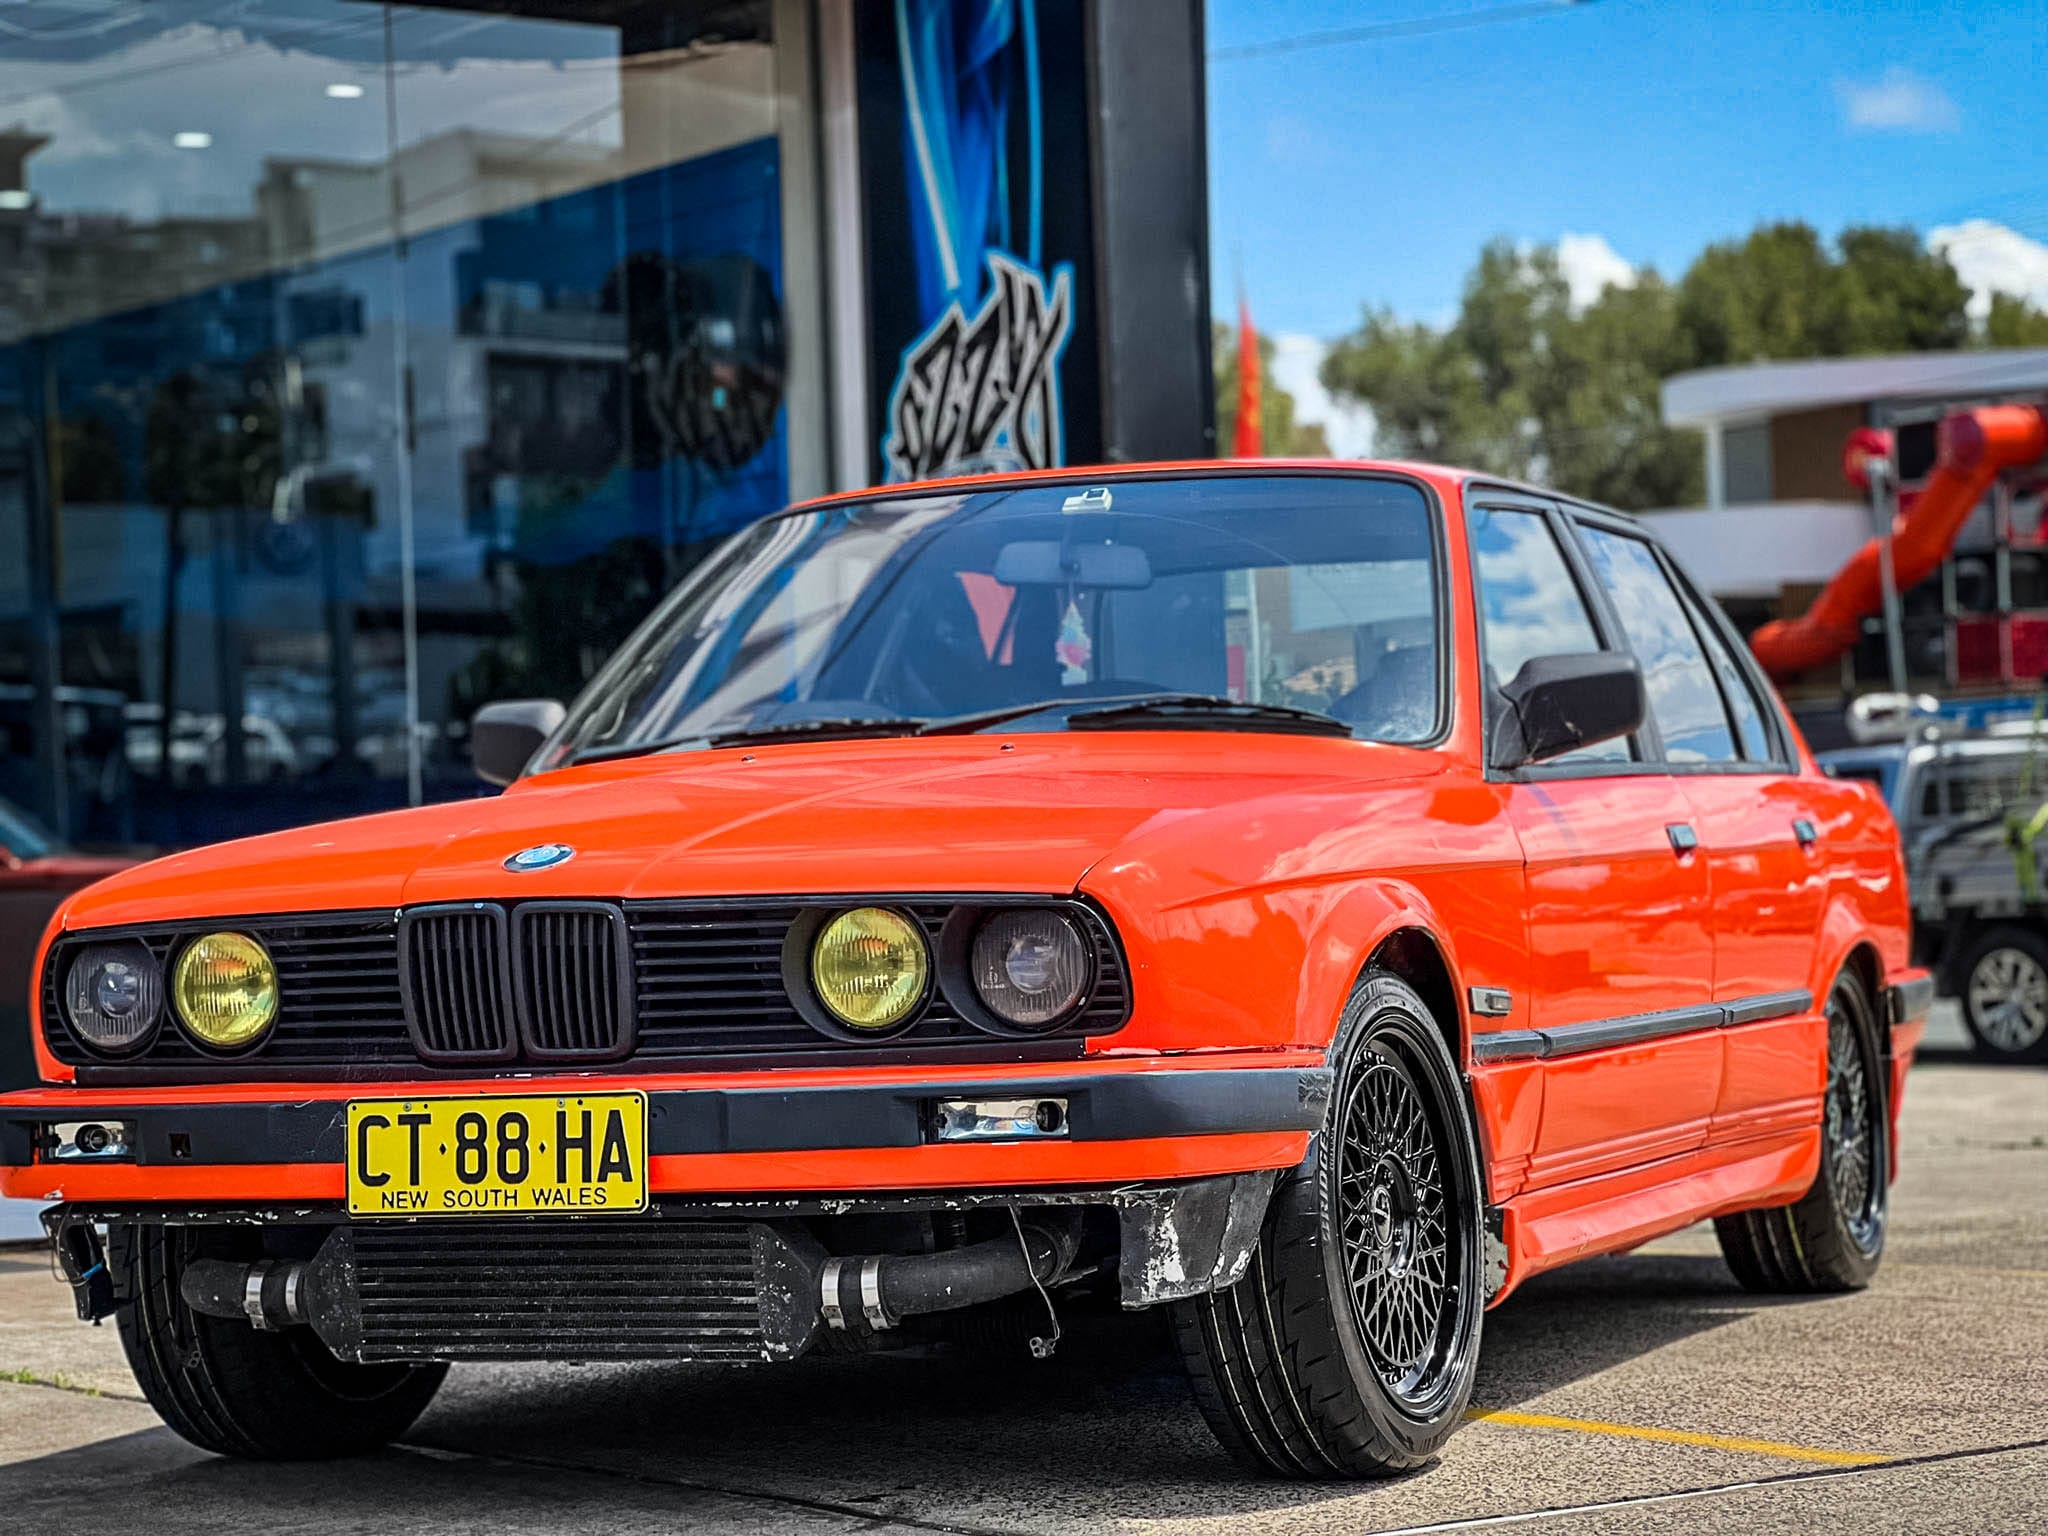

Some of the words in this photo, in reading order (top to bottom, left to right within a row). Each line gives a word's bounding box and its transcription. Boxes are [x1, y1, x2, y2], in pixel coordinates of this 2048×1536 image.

[381, 1190, 429, 1209] NEW
[443, 1189, 518, 1208] SOUTH
[531, 1187, 607, 1207] WALES
